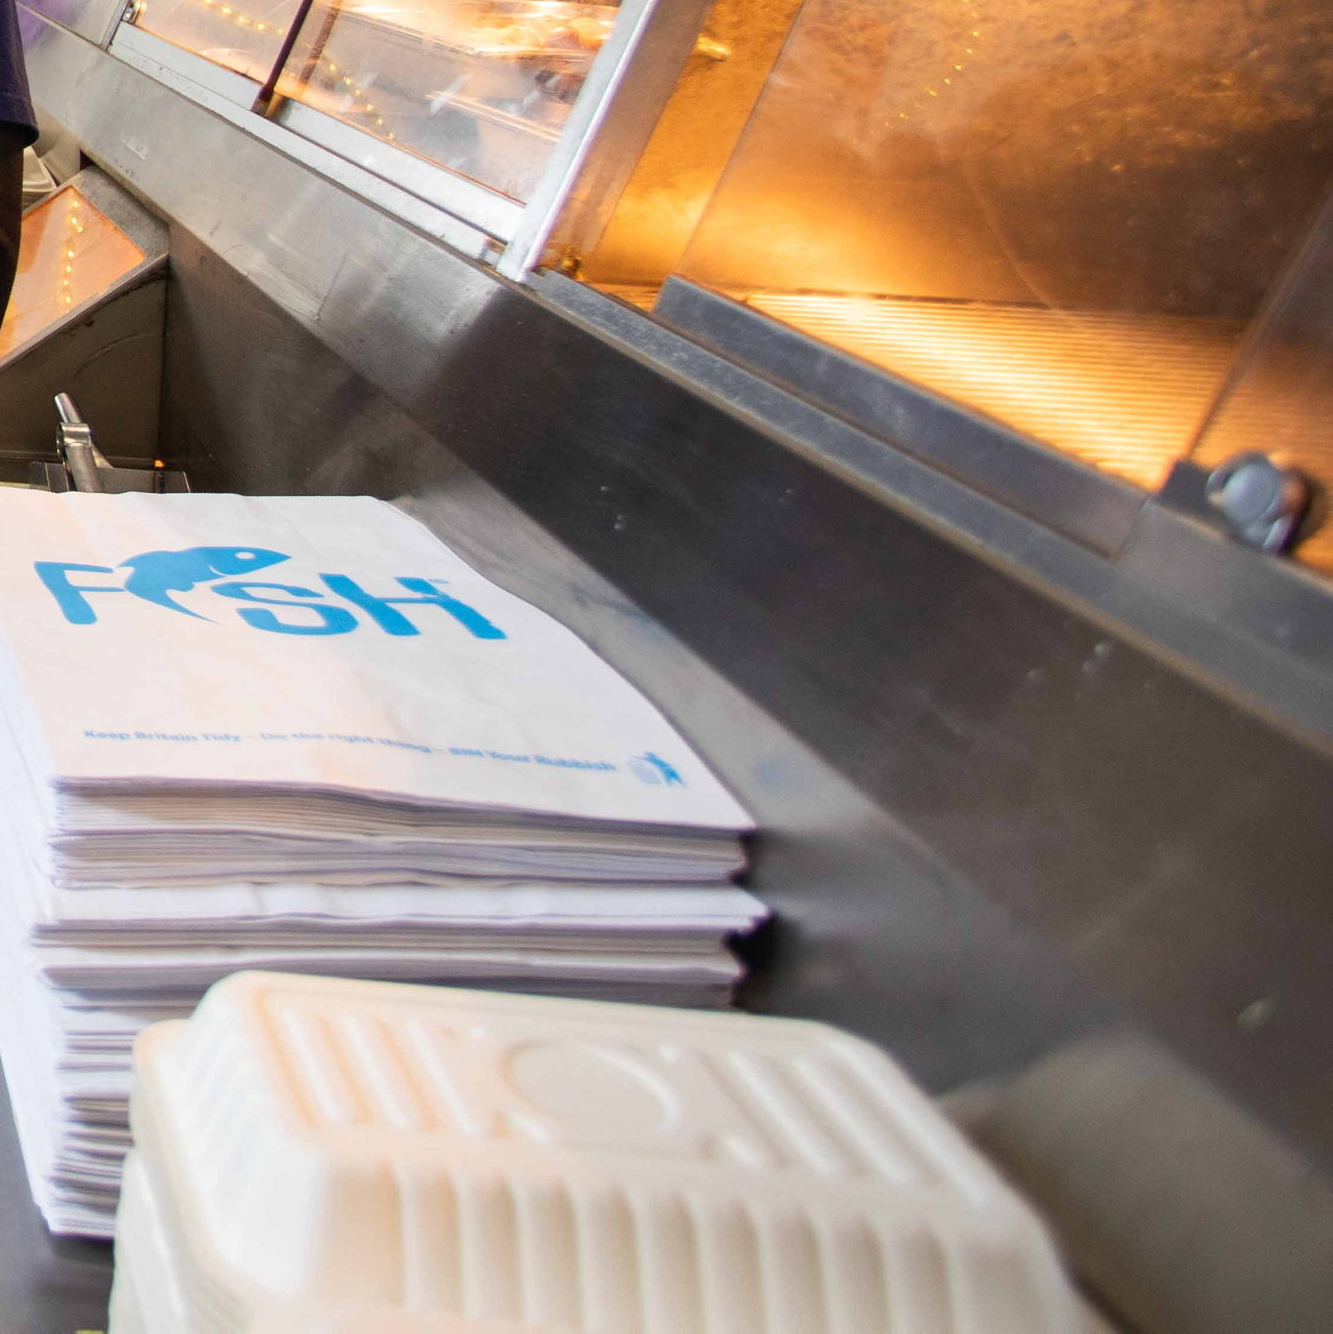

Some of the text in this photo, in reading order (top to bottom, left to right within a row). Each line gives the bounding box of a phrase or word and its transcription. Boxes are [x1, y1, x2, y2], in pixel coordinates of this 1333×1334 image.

[84, 729, 130, 741] Keep
[134, 730, 199, 742] Britain
[201, 732, 242, 743] Tidy
[328, 733, 374, 745] right
[534, 754, 617, 772] Rubbish
